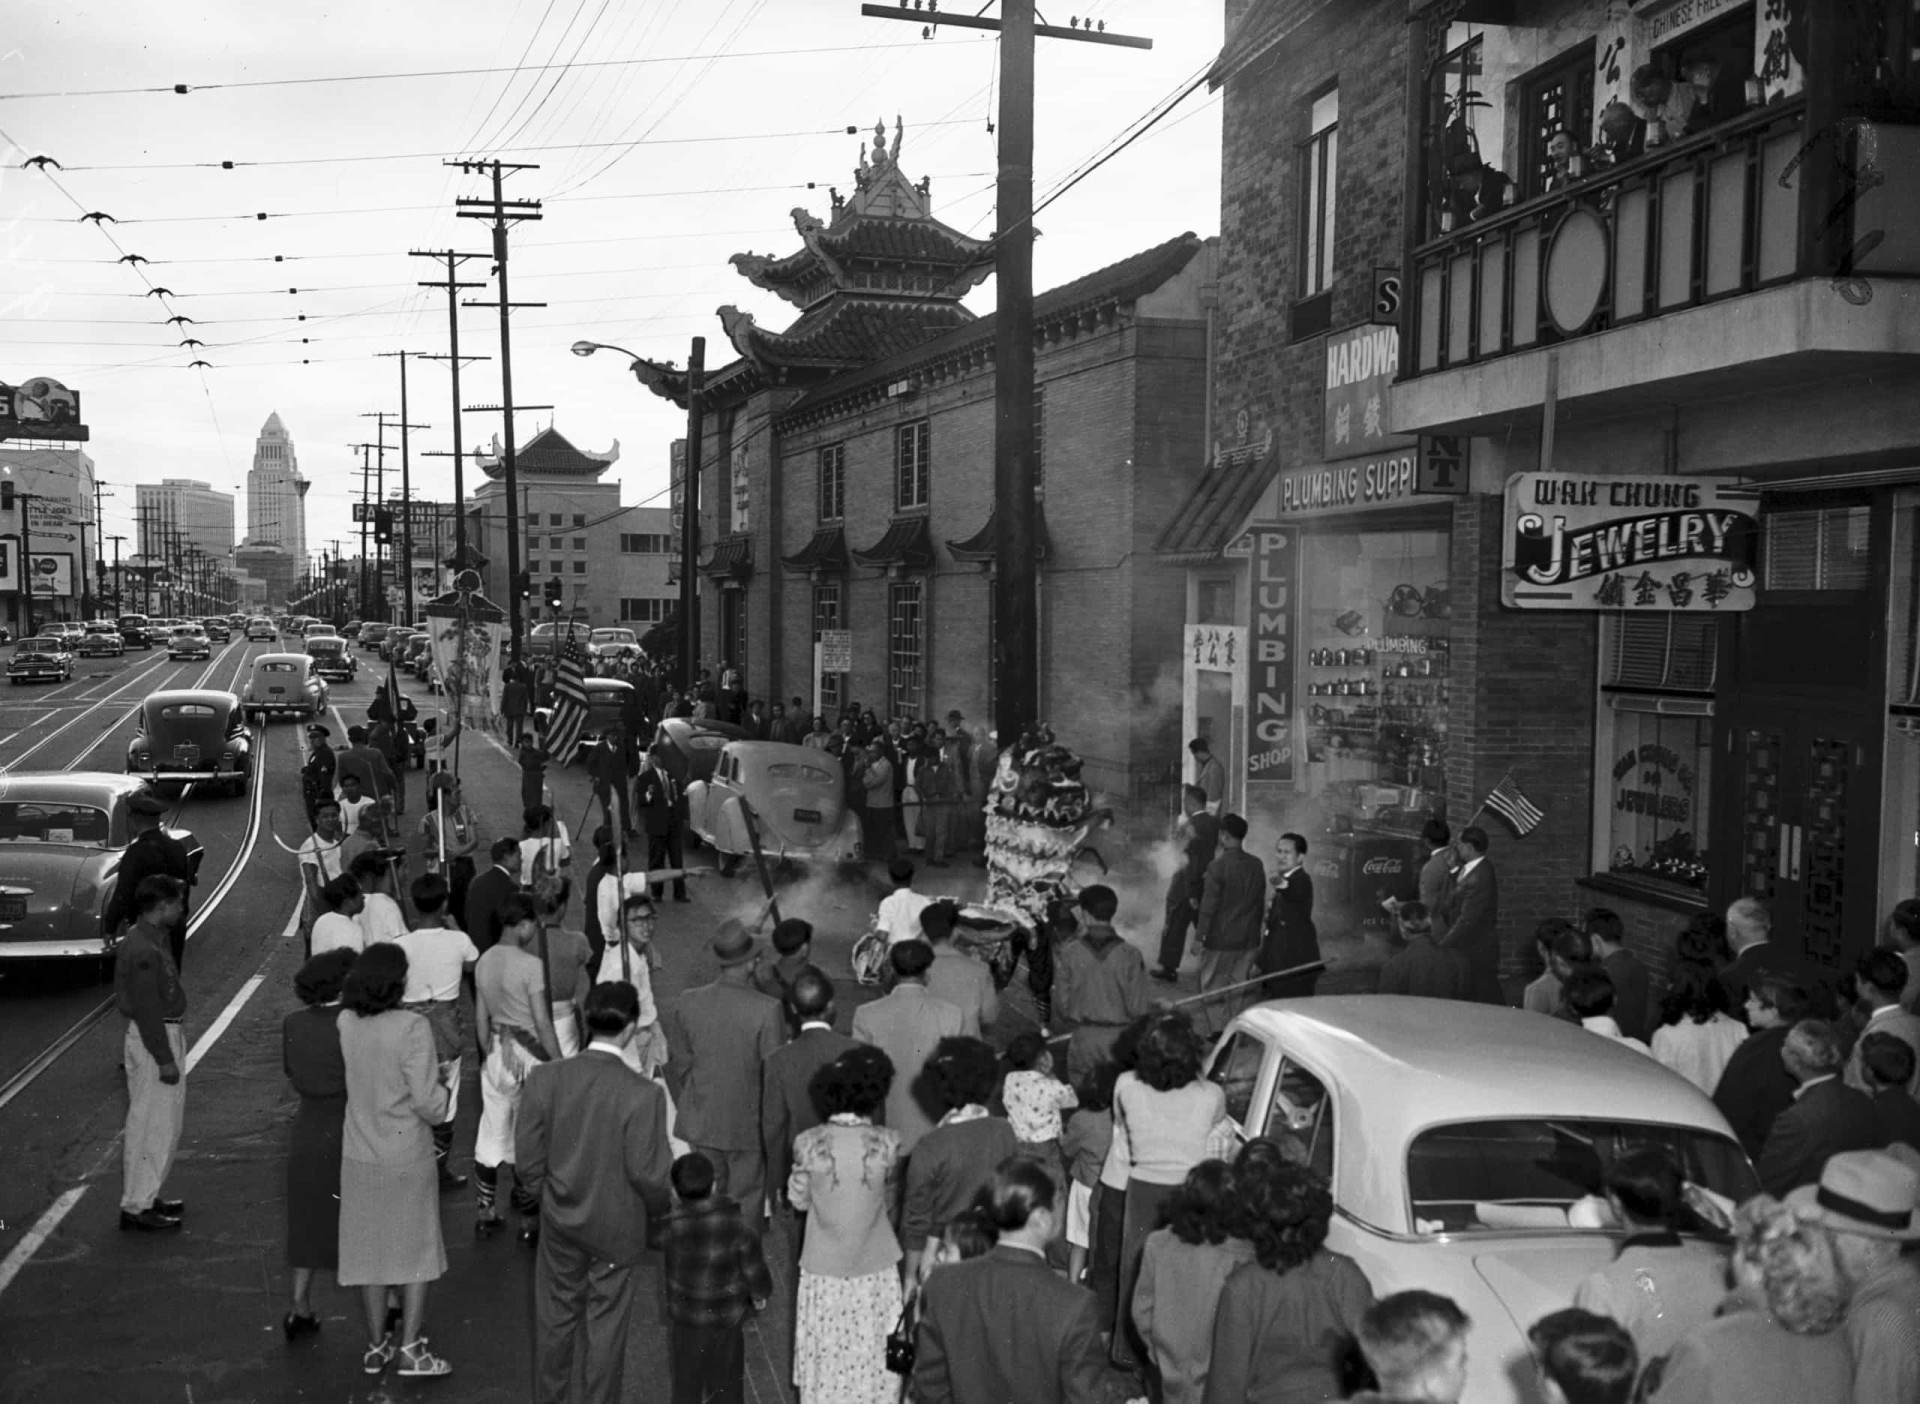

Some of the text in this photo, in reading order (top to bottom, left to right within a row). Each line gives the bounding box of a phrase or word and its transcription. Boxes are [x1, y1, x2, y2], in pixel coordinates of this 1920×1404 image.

[1653, 1, 1693, 39] CHINESE
[1282, 466, 1357, 512] PLUMBING
[1534, 479, 1702, 508] WAH CHUNG
[1527, 513, 1738, 585] JEWELRY
[1256, 532, 1288, 742] PLUMBING
[1367, 634, 1427, 655] PLUMBING
[1249, 747, 1292, 772] SHOP
